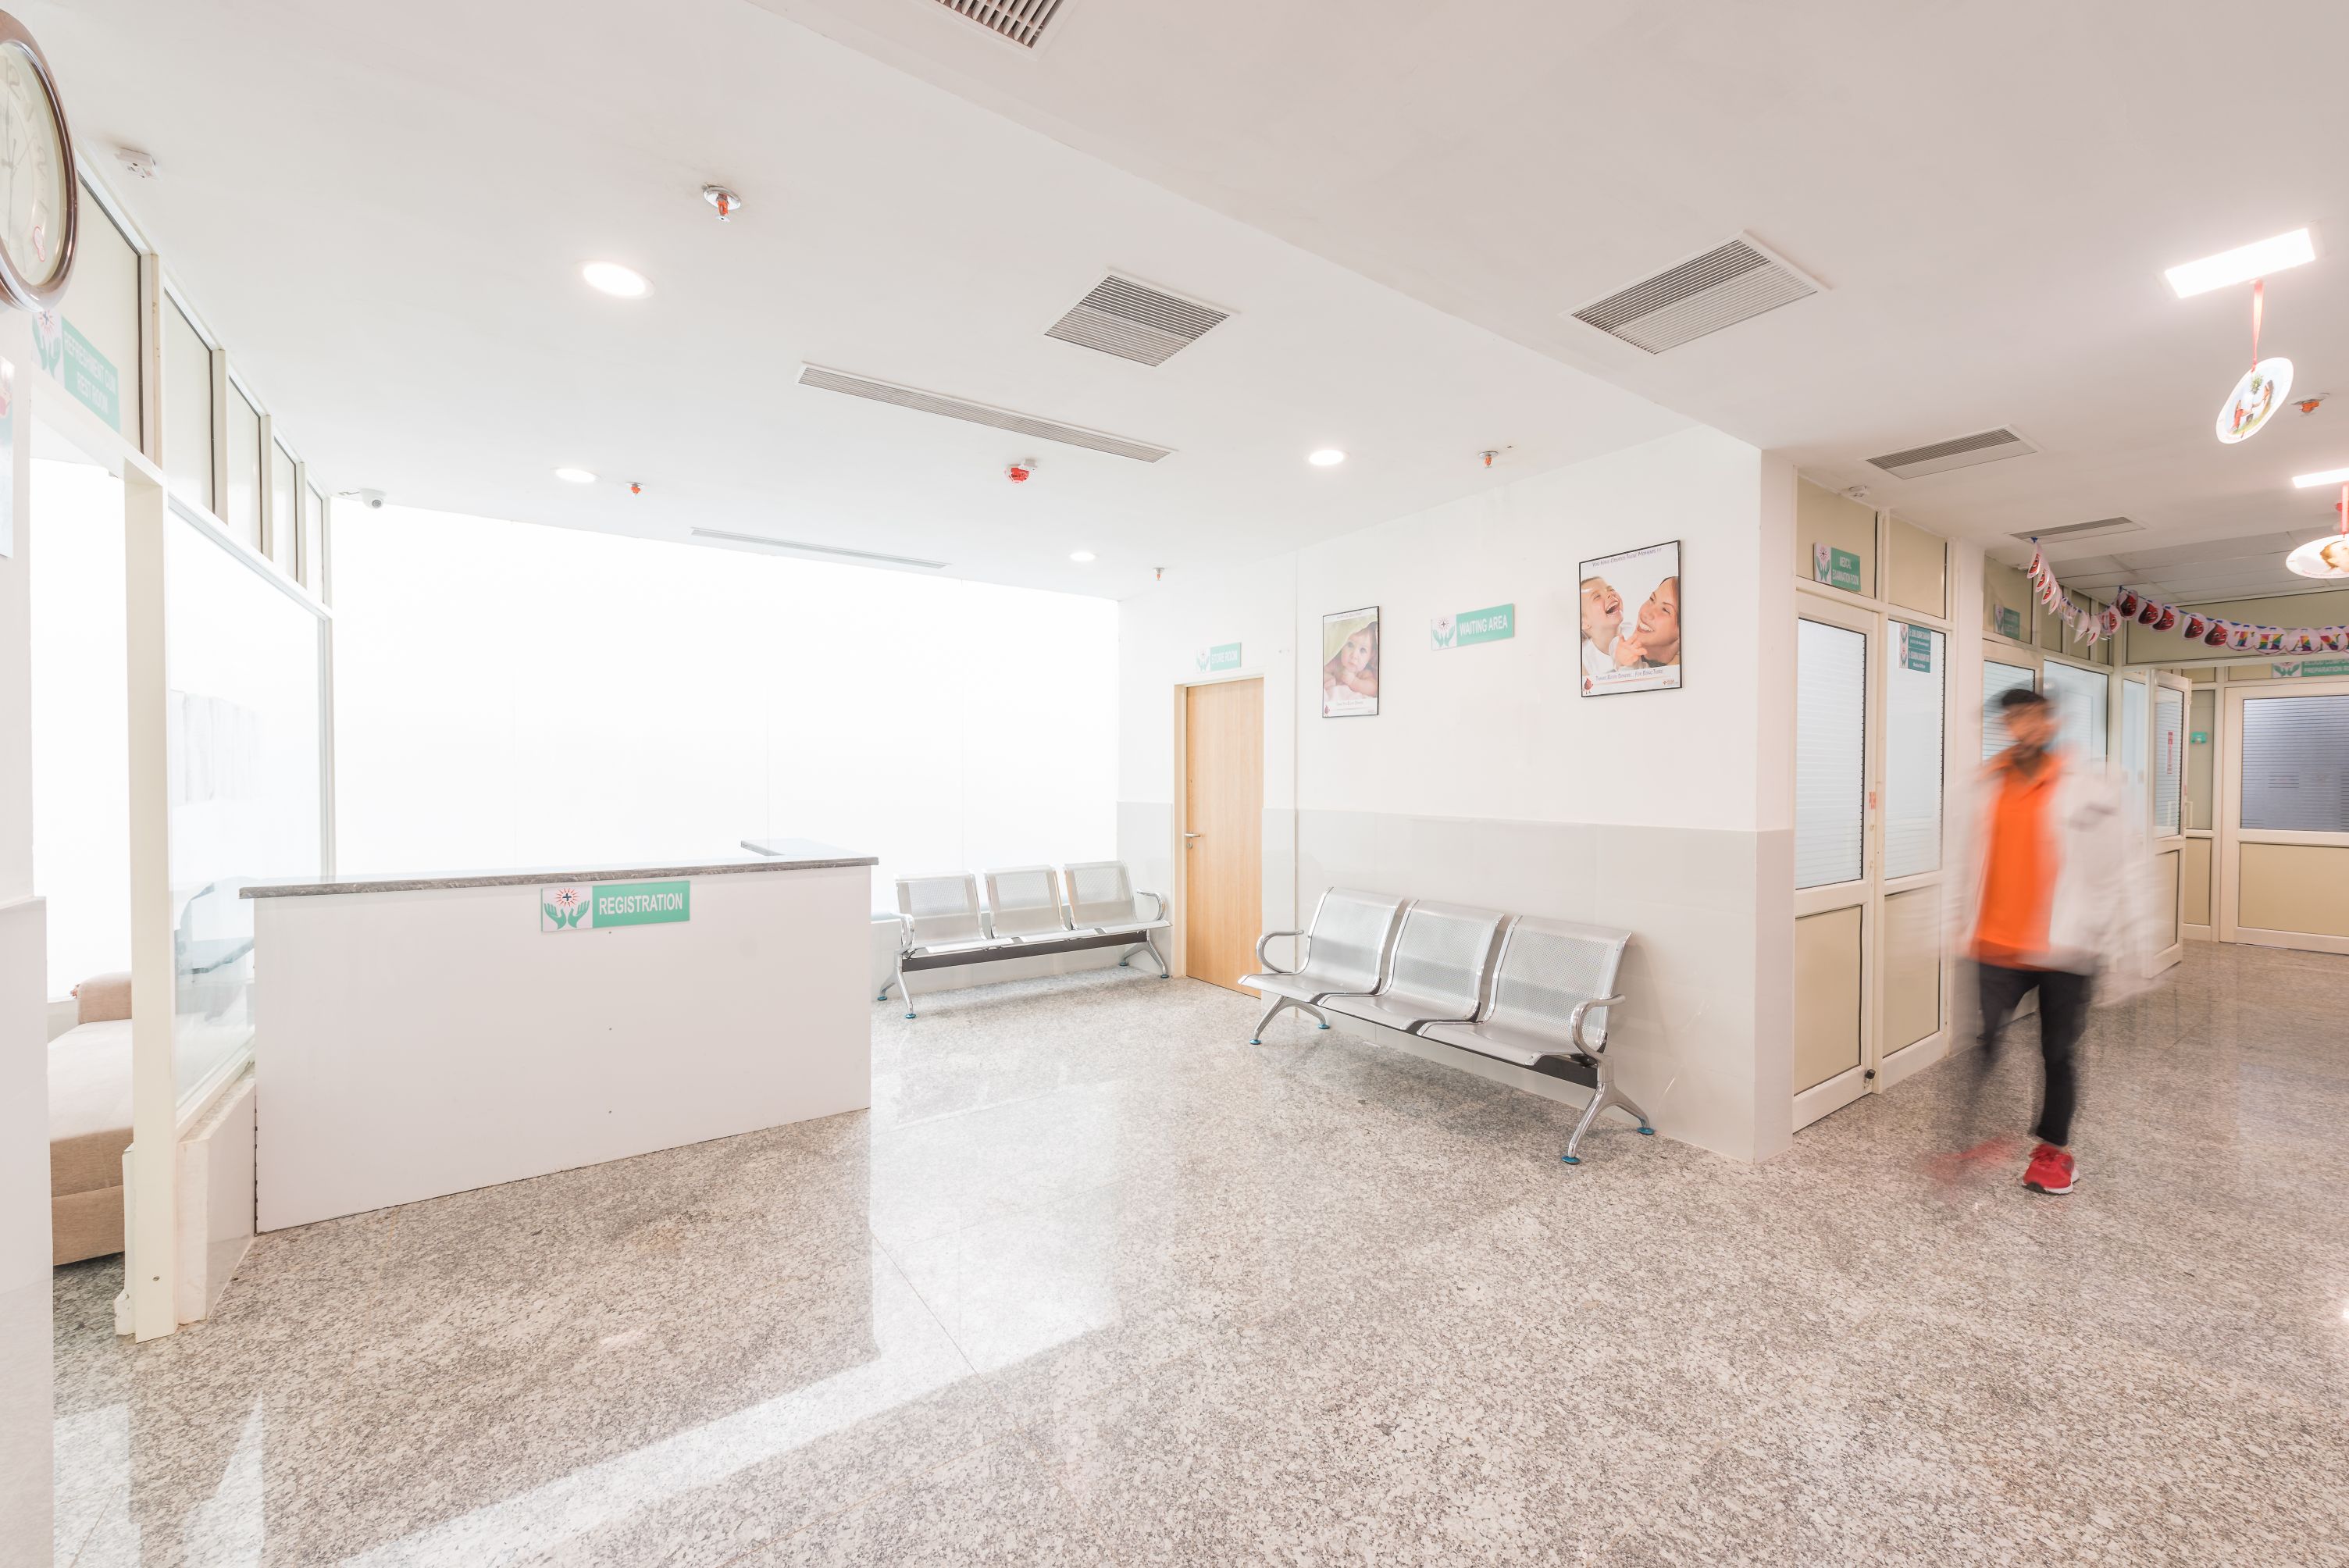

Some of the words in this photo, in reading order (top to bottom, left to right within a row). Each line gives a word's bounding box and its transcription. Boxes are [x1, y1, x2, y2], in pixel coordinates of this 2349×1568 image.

[1459, 618, 1488, 637] WAITING
[1488, 614, 1509, 632] AREA
[1225, 649, 1237, 663] ROOM
[599, 893, 683, 915] REGISTRATION
